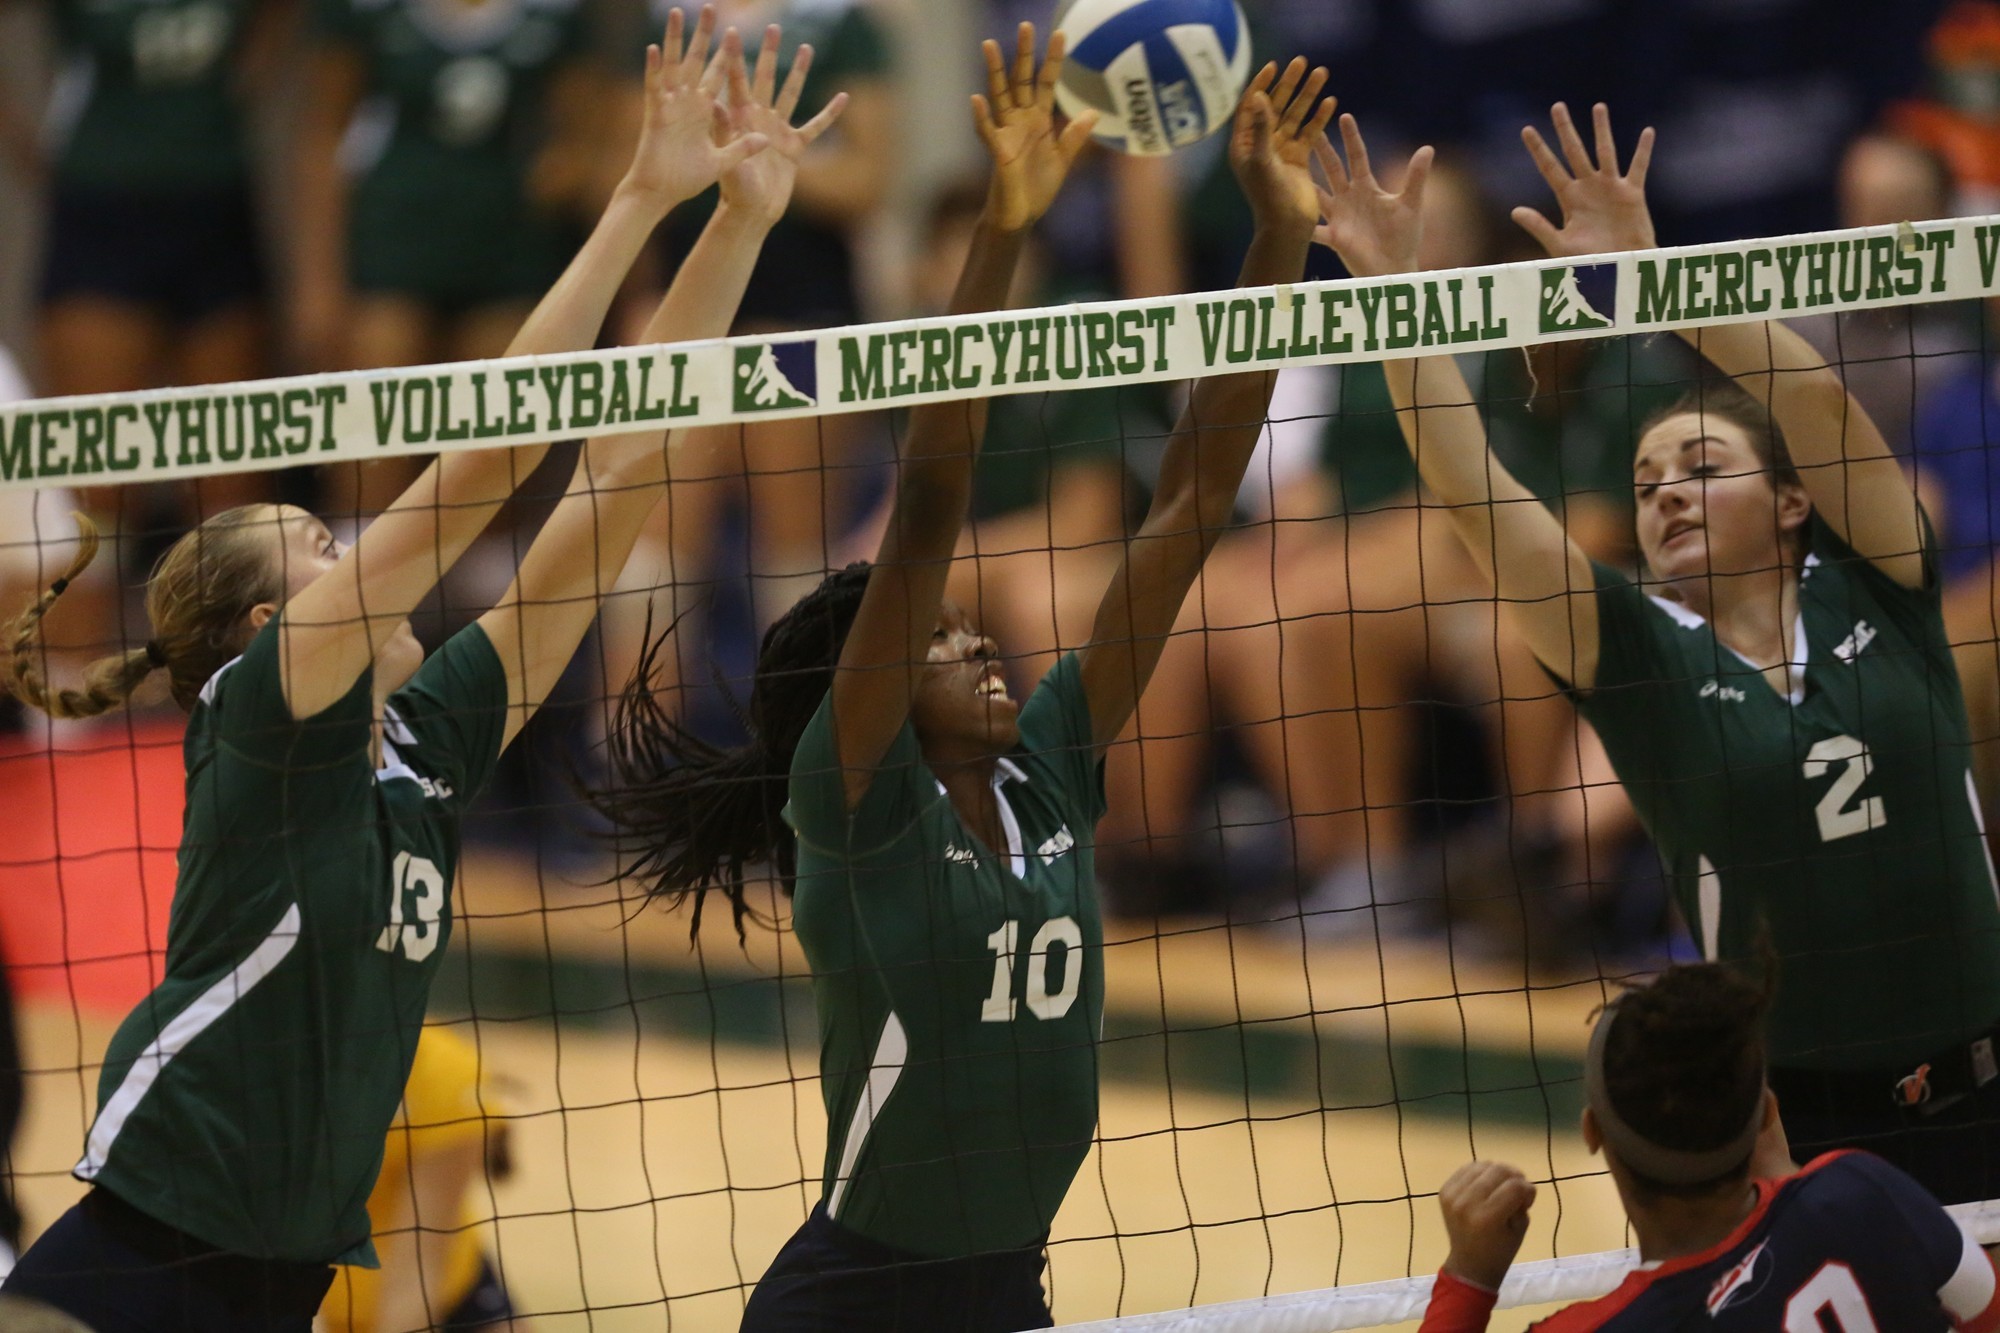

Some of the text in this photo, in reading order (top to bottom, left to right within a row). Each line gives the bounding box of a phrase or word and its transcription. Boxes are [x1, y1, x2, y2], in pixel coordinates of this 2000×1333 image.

[1635, 229, 1955, 324] MERCYHURST
[838, 275, 1508, 403] MERCYHURST VOLLEYBALL
[0, 353, 699, 480] MERCYHURST VOLLEYBALL
[1802, 734, 1887, 842] 2
[375, 850, 444, 962] 13
[981, 915, 1083, 1022] 10
